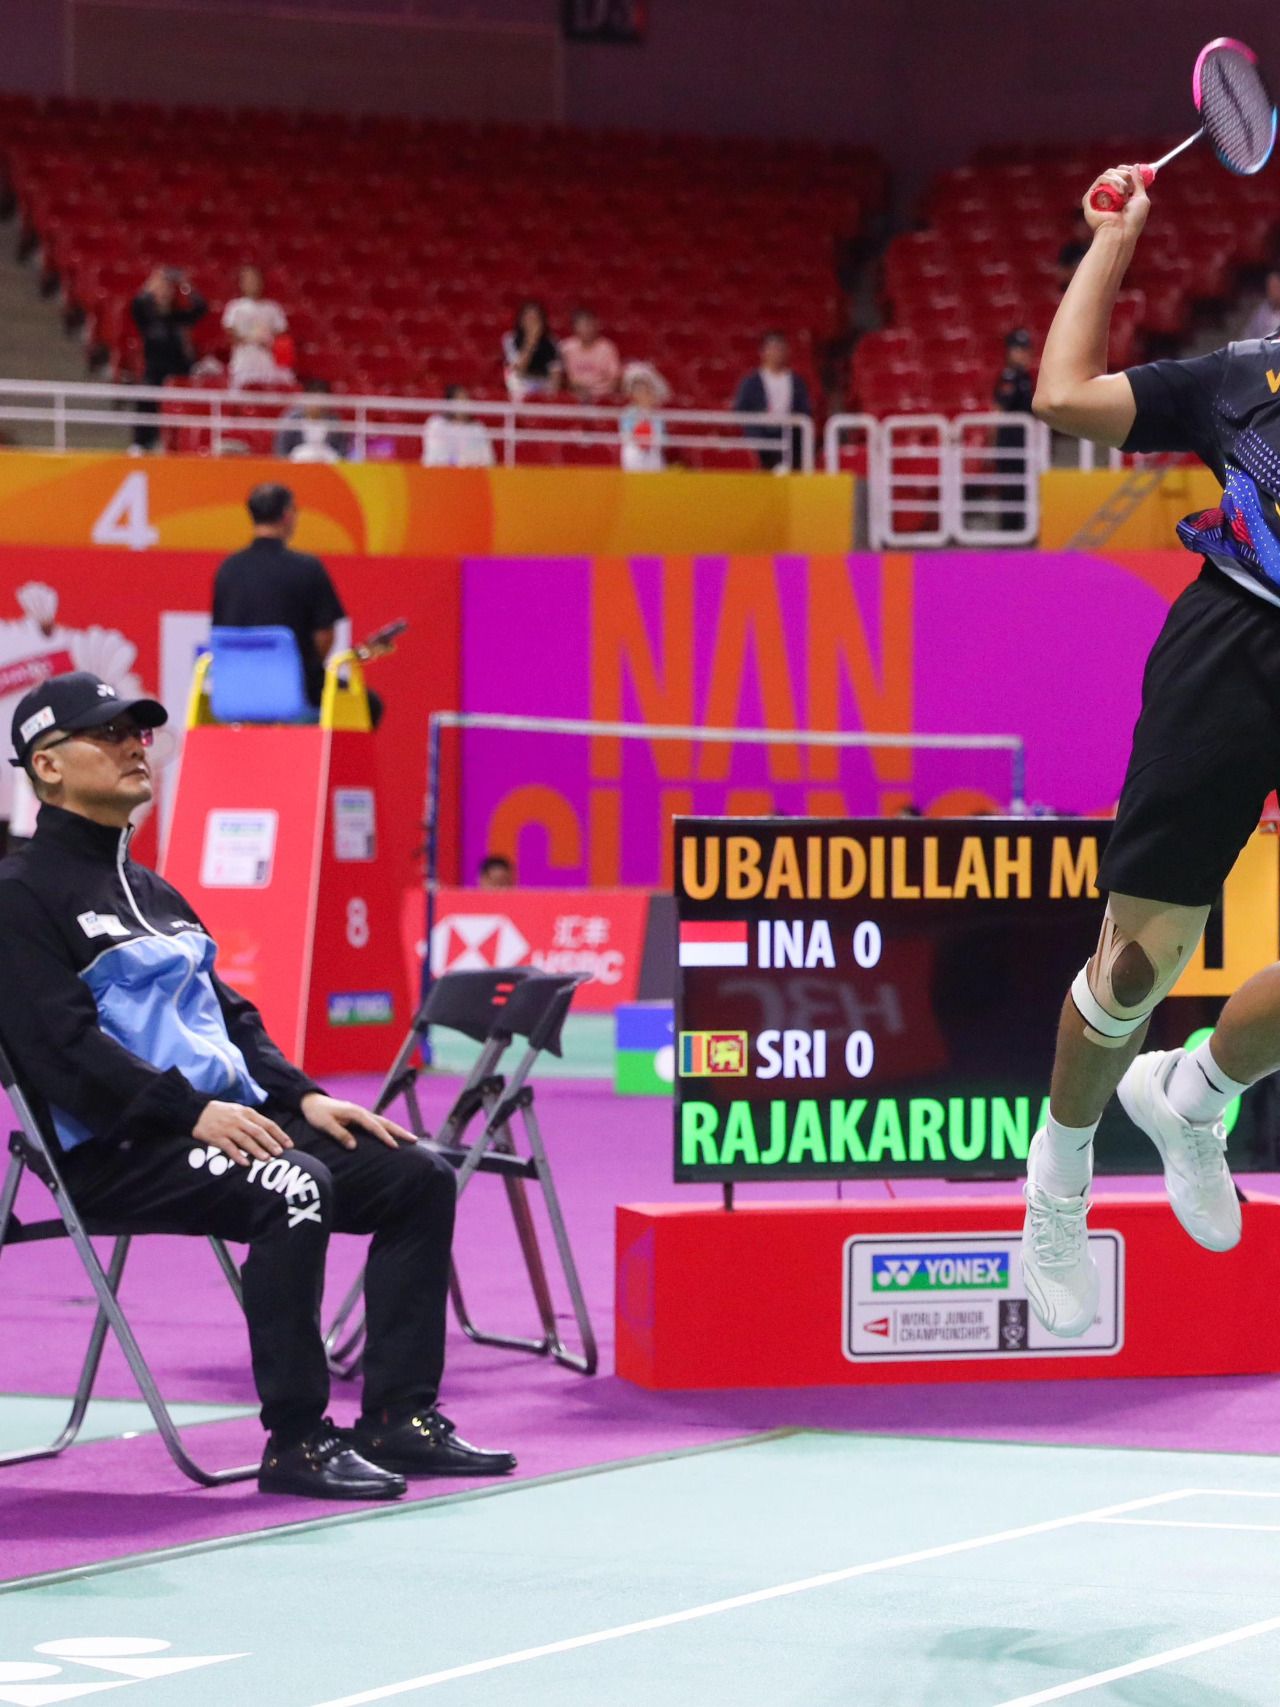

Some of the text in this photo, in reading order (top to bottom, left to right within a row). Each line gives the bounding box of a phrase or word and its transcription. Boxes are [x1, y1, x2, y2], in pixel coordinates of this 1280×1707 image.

[91, 470, 160, 551] 4
[589, 556, 914, 781] NAN
[682, 836, 1032, 900] UBAIDILLAH
[346, 897, 370, 948] 8
[553, 915, 611, 949] 汇丰
[757, 919, 882, 969] INA 0
[755, 1029, 874, 1079] SRI 0
[681, 1097, 1050, 1165] RAJAKARUN
[246, 1156, 322, 1229] YONEX
[925, 1257, 1002, 1286] YONEX
[901, 1311, 984, 1326] WORLD JUNIOR
[901, 1326, 991, 1342] CHAMPIONSHIPS
